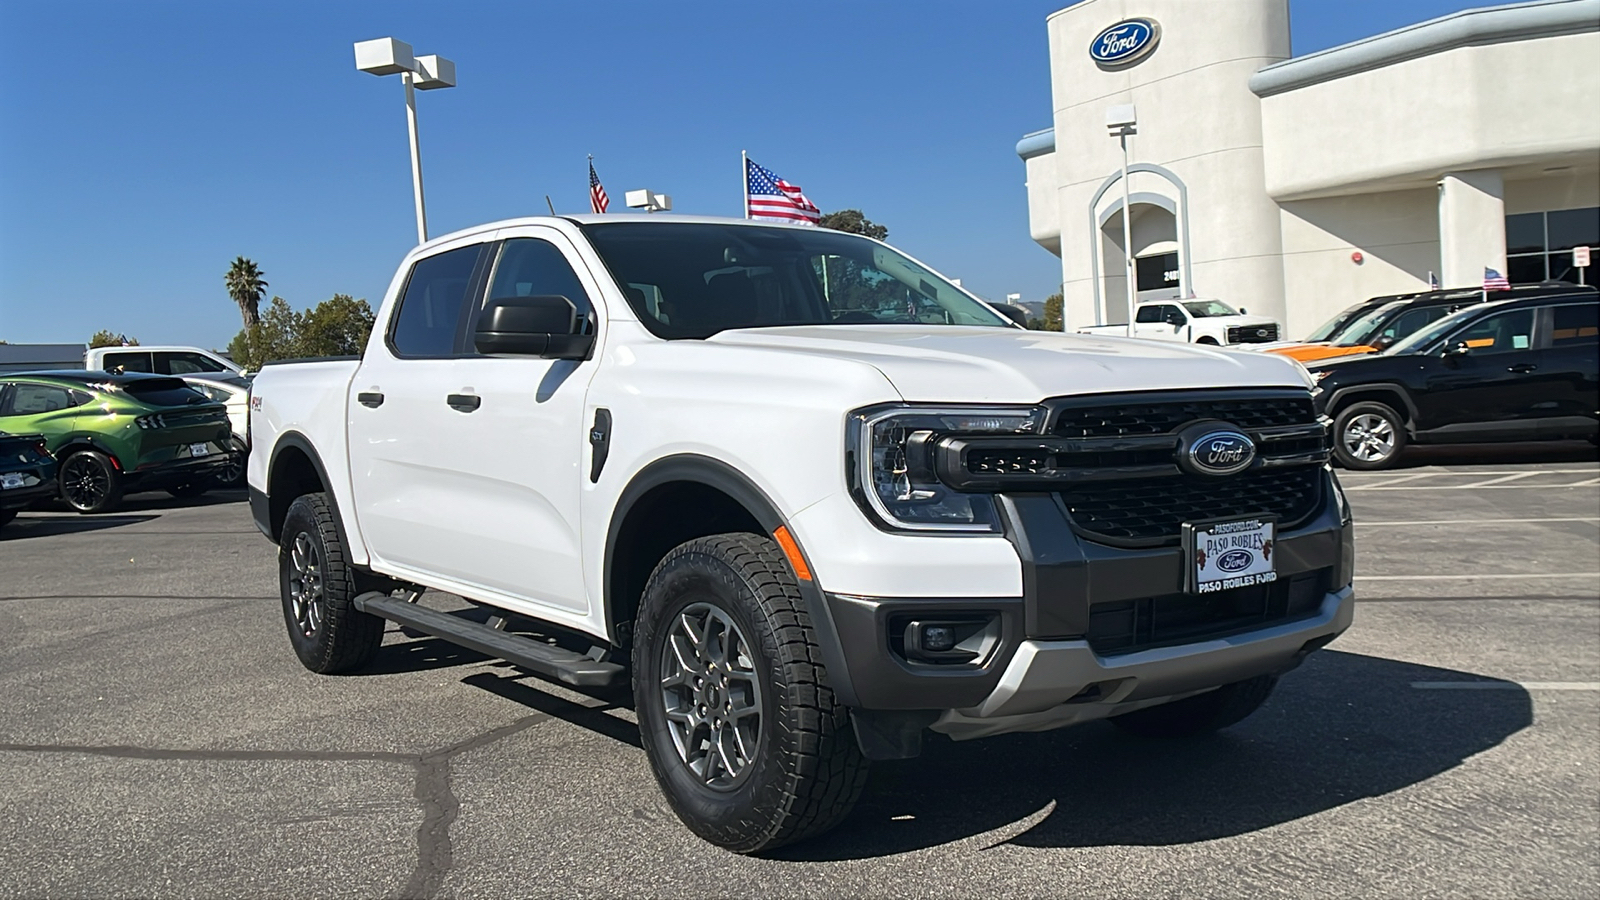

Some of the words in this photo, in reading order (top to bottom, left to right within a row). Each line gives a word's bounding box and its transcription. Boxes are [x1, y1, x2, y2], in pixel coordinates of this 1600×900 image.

[1100, 27, 1139, 57] Ford
[1208, 440, 1243, 464] Ford
[1207, 537, 1228, 558] PASO
[1232, 533, 1263, 550] ROBLES
[1224, 554, 1247, 568] Ford
[1199, 581, 1221, 593] PASO
[1223, 576, 1255, 589] ROBLES
